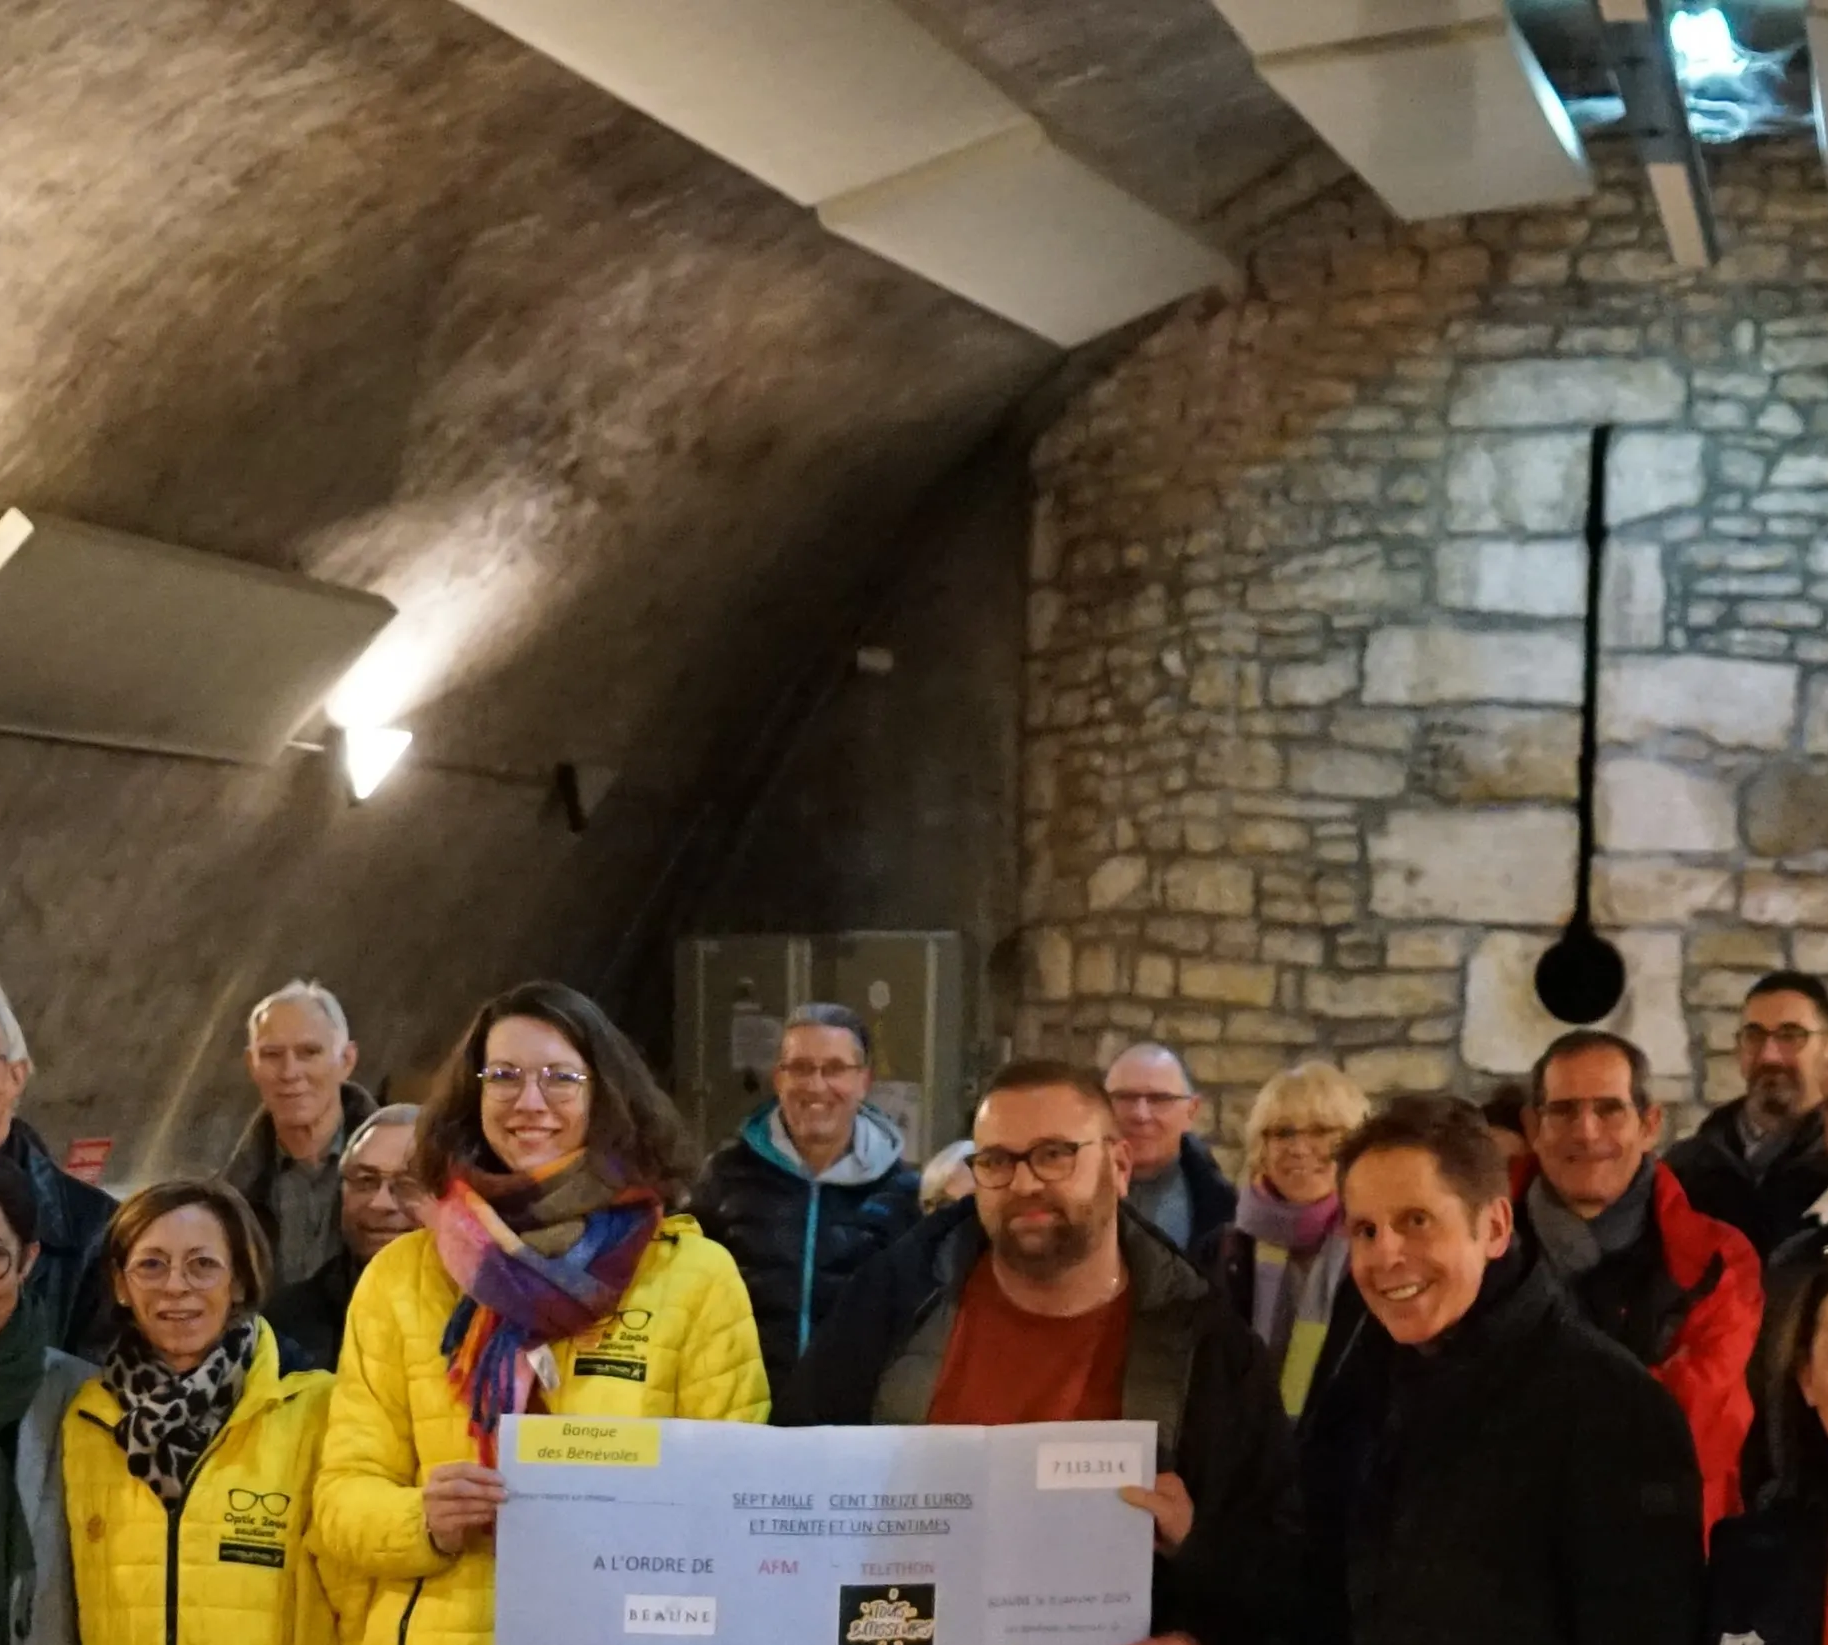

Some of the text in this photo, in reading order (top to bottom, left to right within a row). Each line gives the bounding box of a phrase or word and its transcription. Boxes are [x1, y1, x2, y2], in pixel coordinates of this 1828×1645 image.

[562, 1422, 617, 1438] Banque
[537, 1446, 639, 1462] des Bénévoles
[733, 1493, 973, 1508] SEPT MILLE CENT TREIZE EUROS
[749, 1519, 951, 1534] ET TRENTE ET UN CENTIMES
[593, 1555, 715, 1574] A L'ORDRE DE
[758, 1559, 799, 1576] AFM
[628, 1608, 712, 1624] BEAUNE
